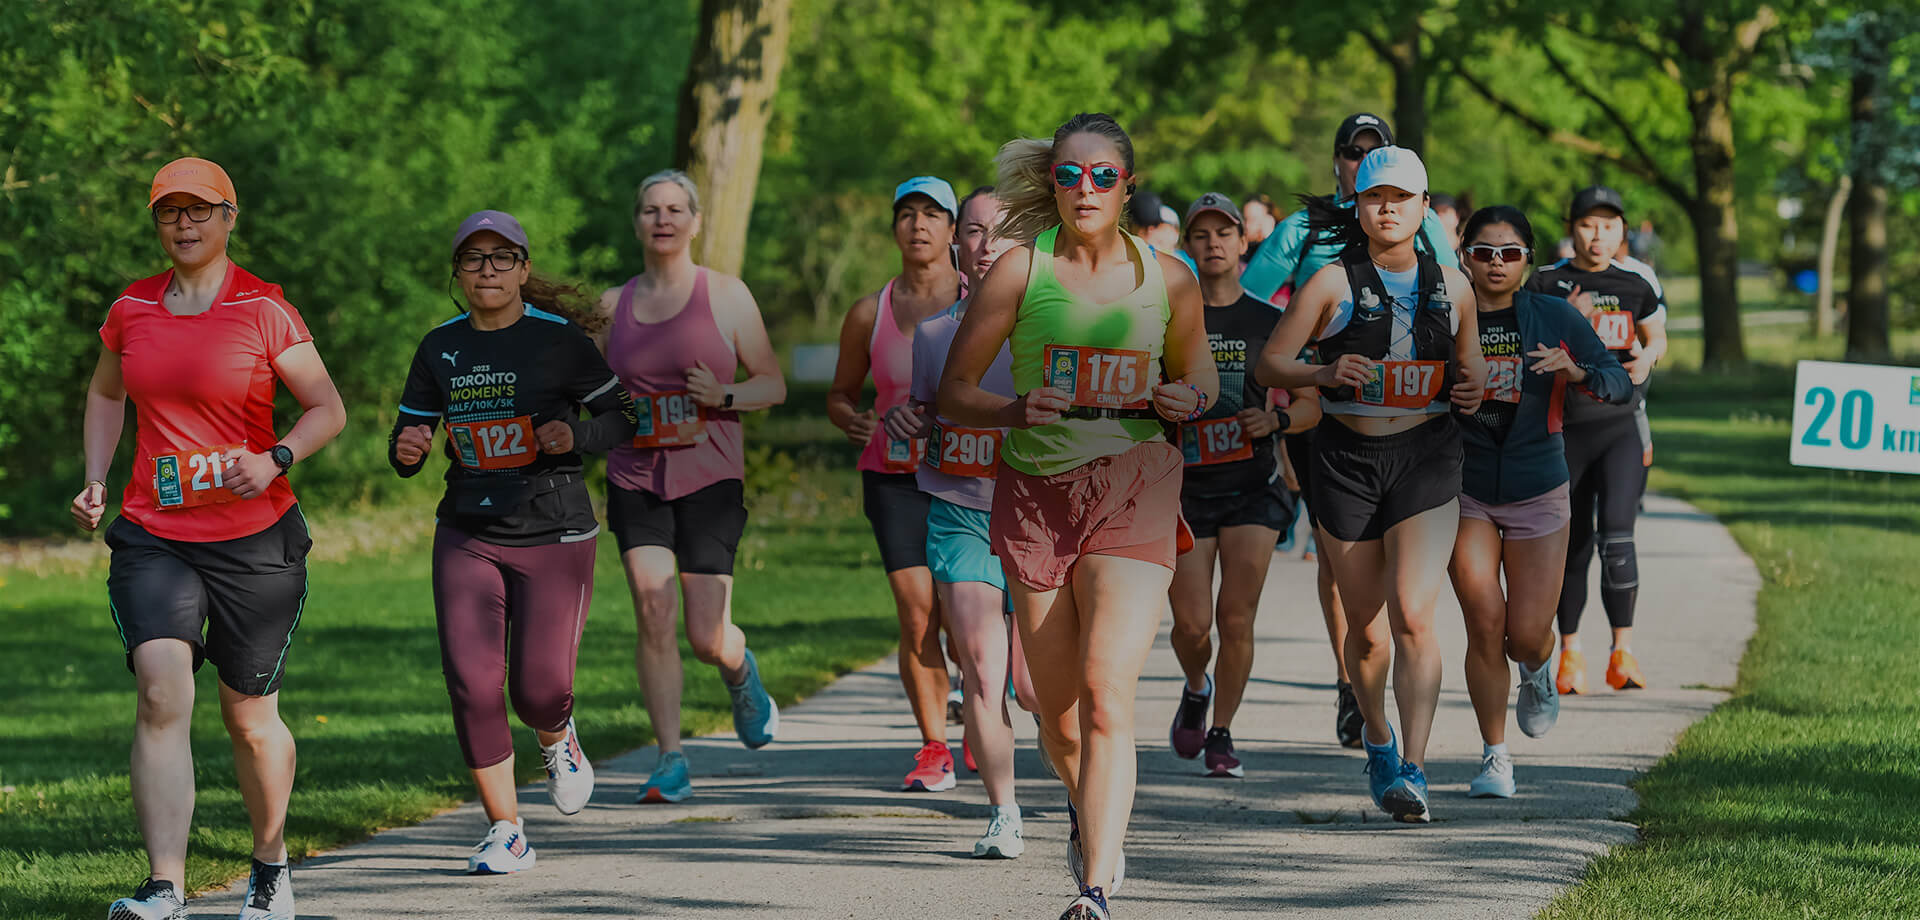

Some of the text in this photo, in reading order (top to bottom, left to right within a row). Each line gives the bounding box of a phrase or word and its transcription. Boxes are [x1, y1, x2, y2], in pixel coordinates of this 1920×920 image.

[1209, 340, 1248, 351] ONTO
[1480, 331, 1521, 345] RONT
[449, 371, 517, 389] TORONTO
[472, 364, 491, 373] 2023
[1088, 352, 1137, 394] 175
[1391, 365, 1435, 396] 197
[447, 398, 515, 414] HALF/10K/5K
[449, 384, 516, 402] WOMEN'S
[656, 394, 699, 425] 195
[1801, 386, 1875, 451] 20
[477, 423, 528, 459] 122
[943, 431, 995, 467] 290
[1203, 421, 1245, 453] 132
[188, 451, 236, 491] 21
